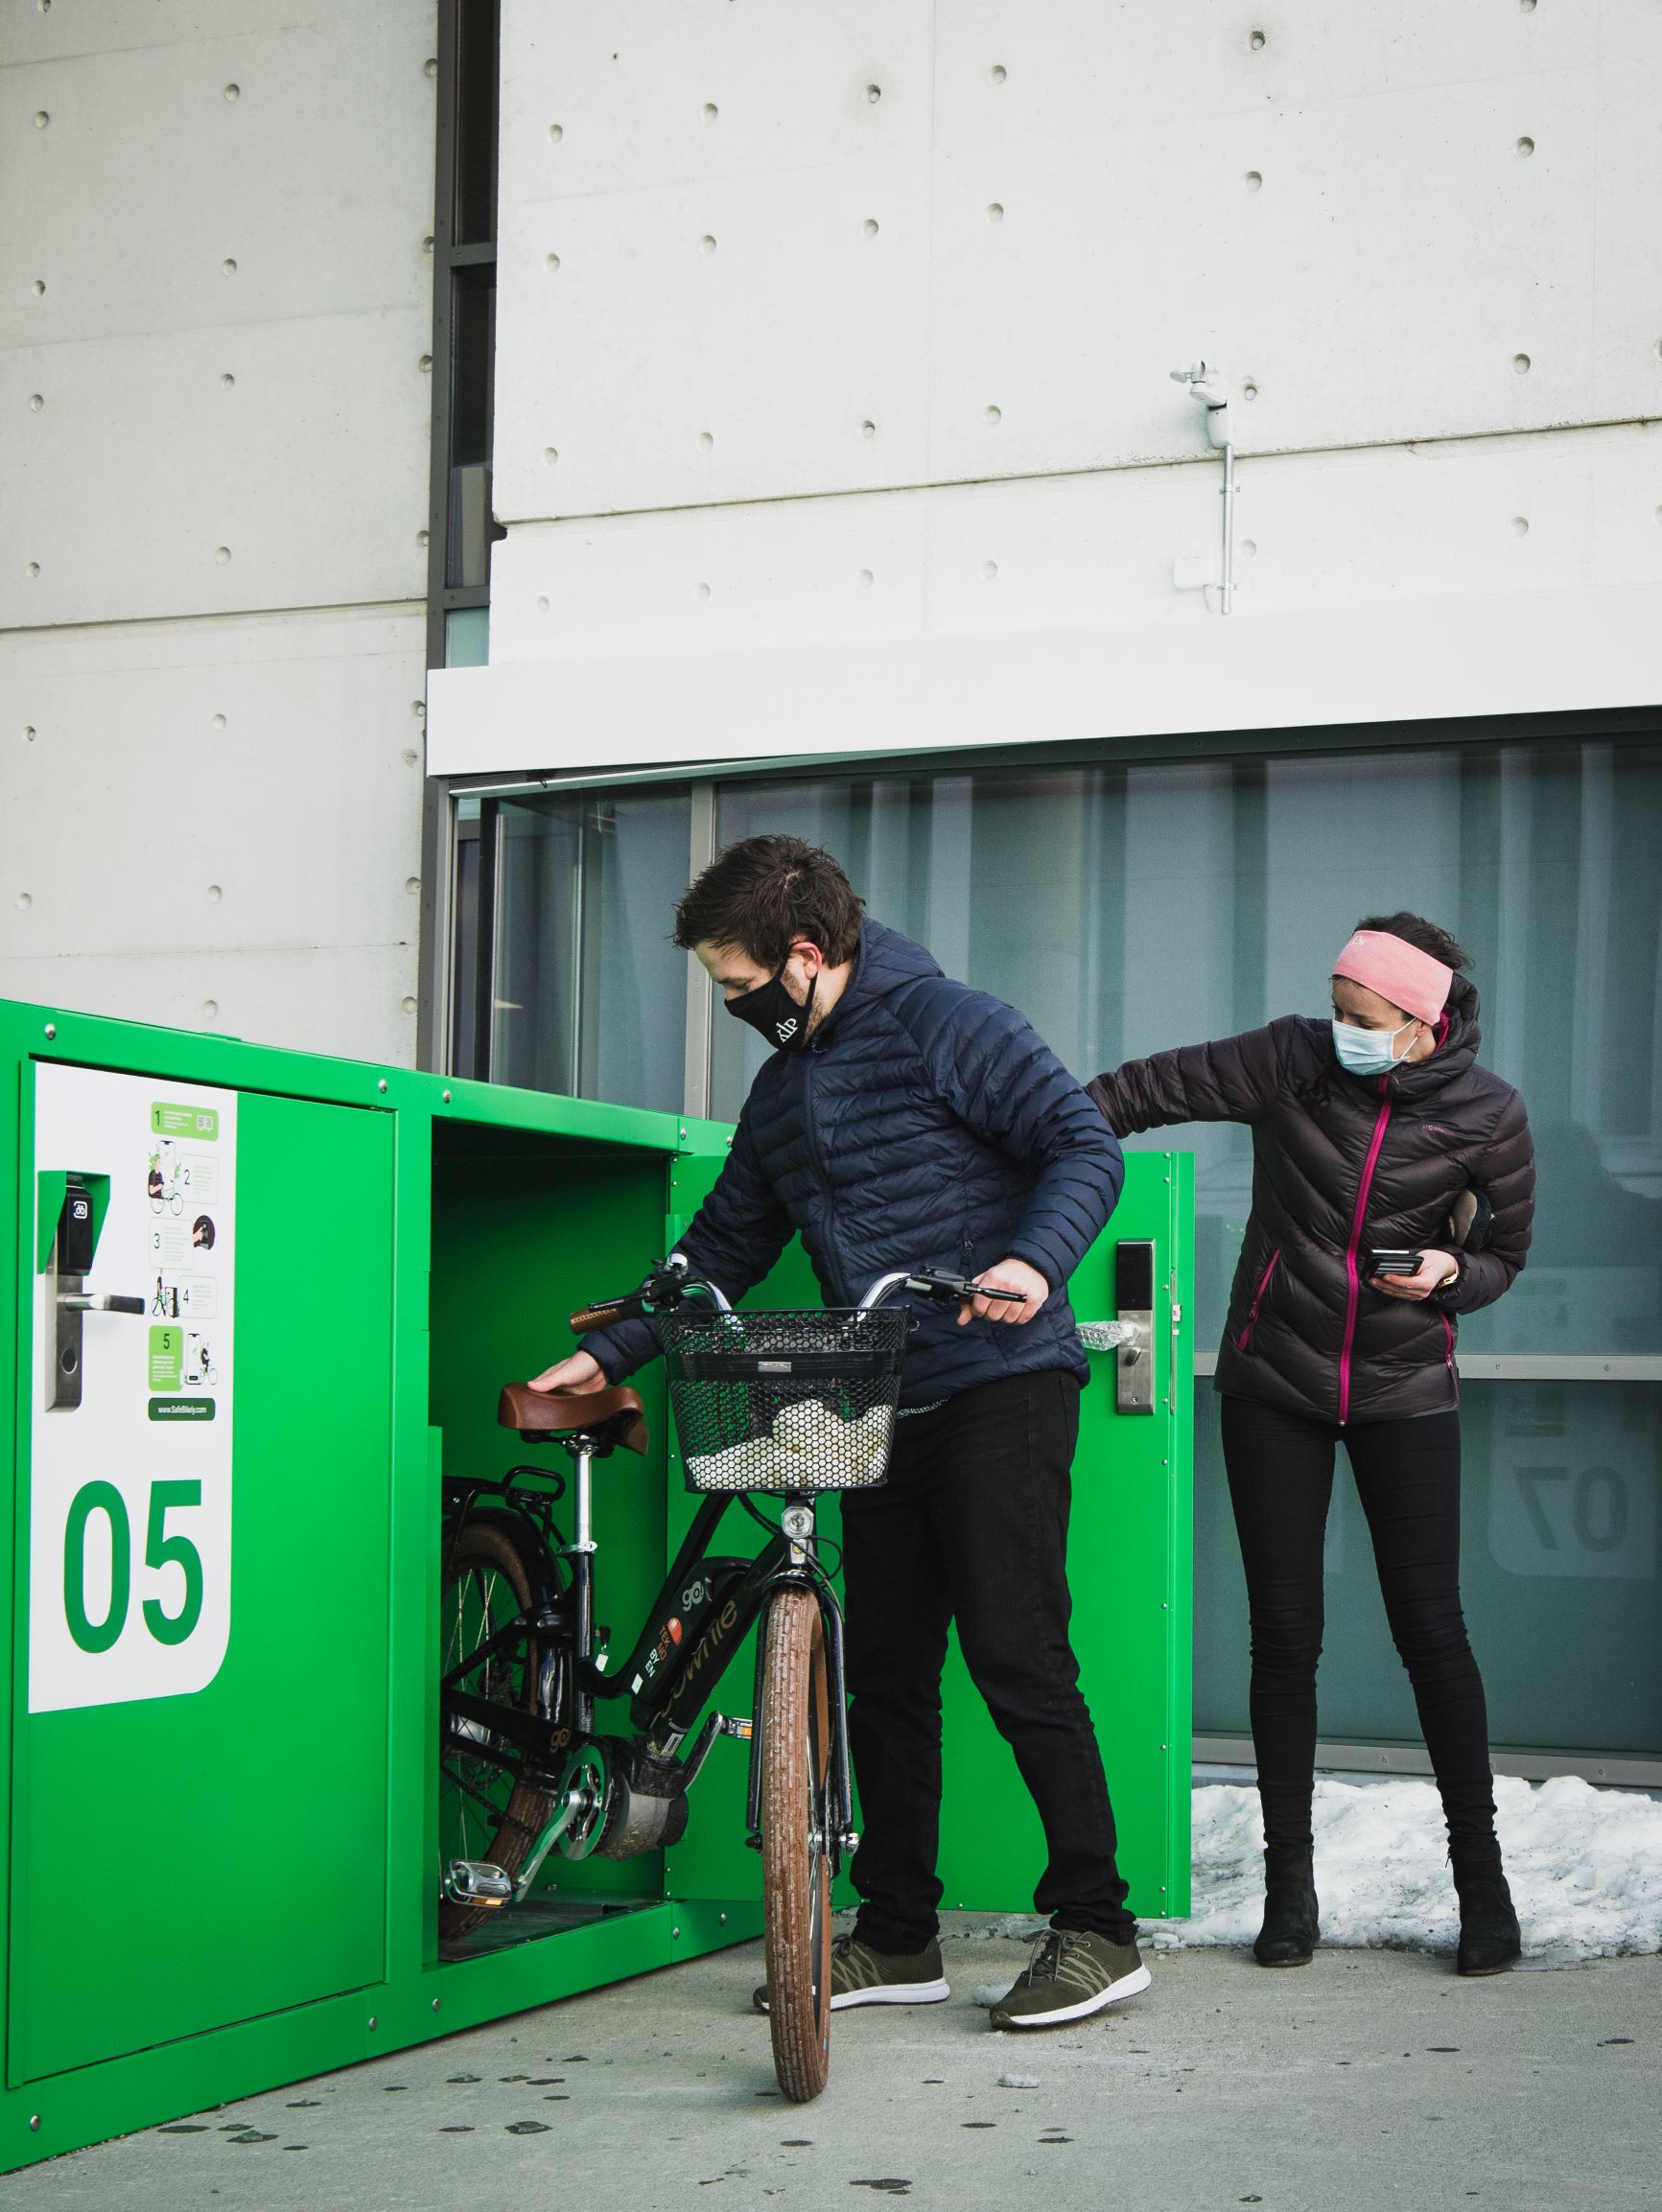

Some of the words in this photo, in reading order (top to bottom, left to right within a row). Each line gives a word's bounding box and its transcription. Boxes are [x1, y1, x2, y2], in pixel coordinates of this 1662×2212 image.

[155, 1110, 160, 1127] 1
[184, 1169, 190, 1185] 2
[153, 1233, 160, 1249] 3
[183, 1288, 189, 1304] 4
[163, 1333, 170, 1349] 5
[63, 1479, 203, 1654] 05
[649, 1648, 660, 1665] BY
[644, 1662, 656, 1678] EN
